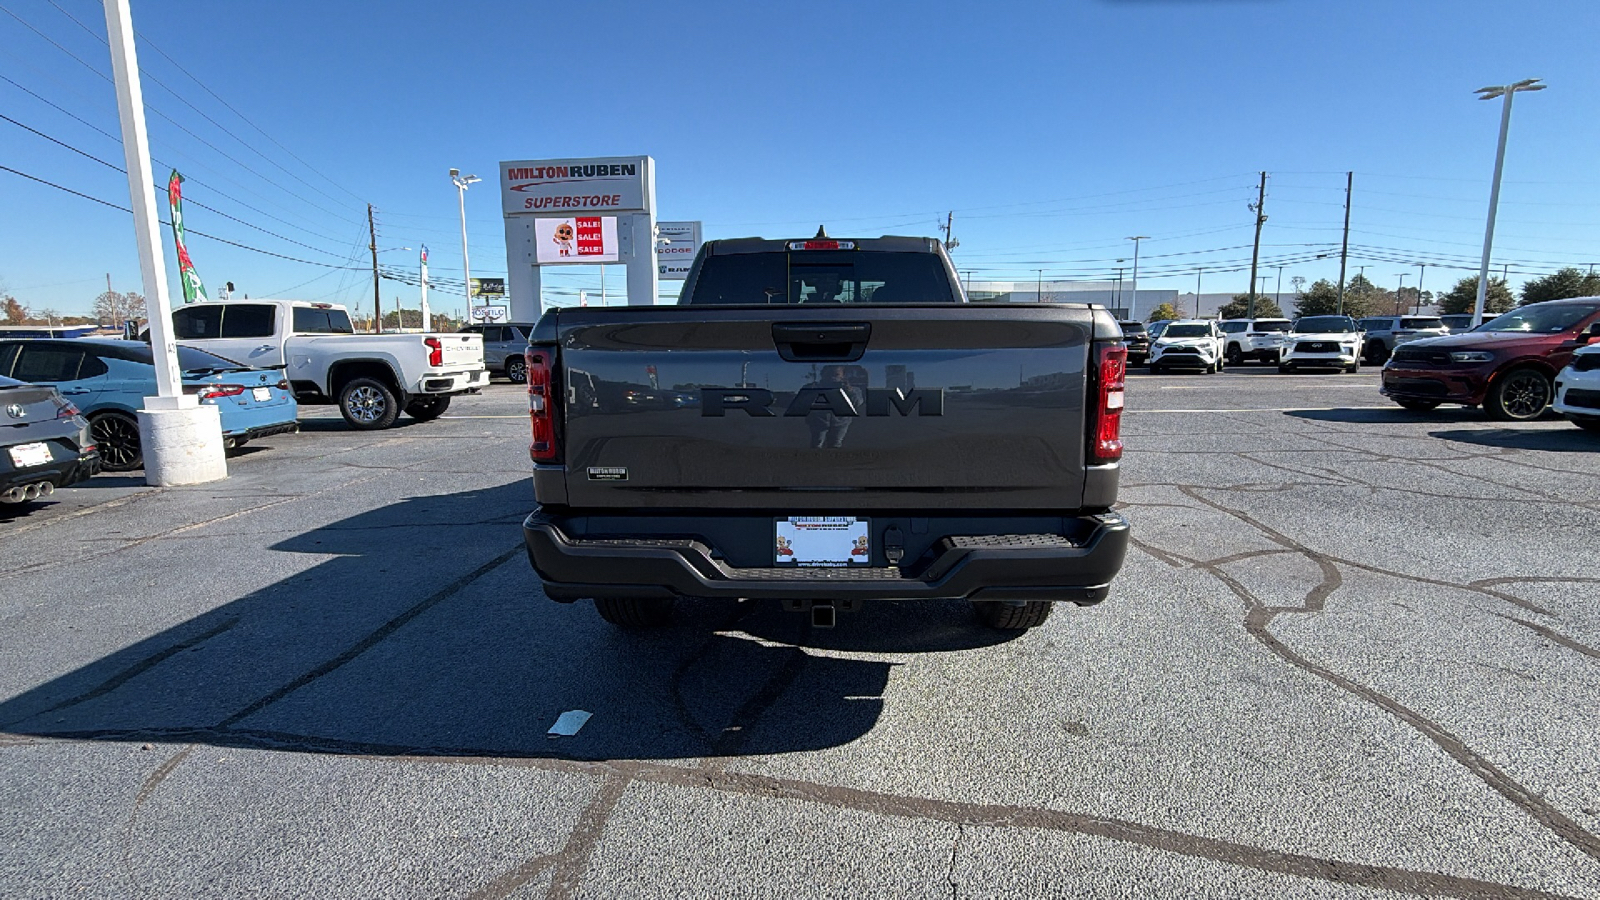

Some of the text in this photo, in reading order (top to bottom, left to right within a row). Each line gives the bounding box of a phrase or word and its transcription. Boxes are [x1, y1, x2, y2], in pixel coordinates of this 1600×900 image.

[524, 194, 621, 209] SUPERSTORE
[577, 221, 601, 229] SALE!
[577, 233, 601, 241] SALE!
[577, 246, 603, 254] SALE!
[701, 387, 944, 417] RAM
